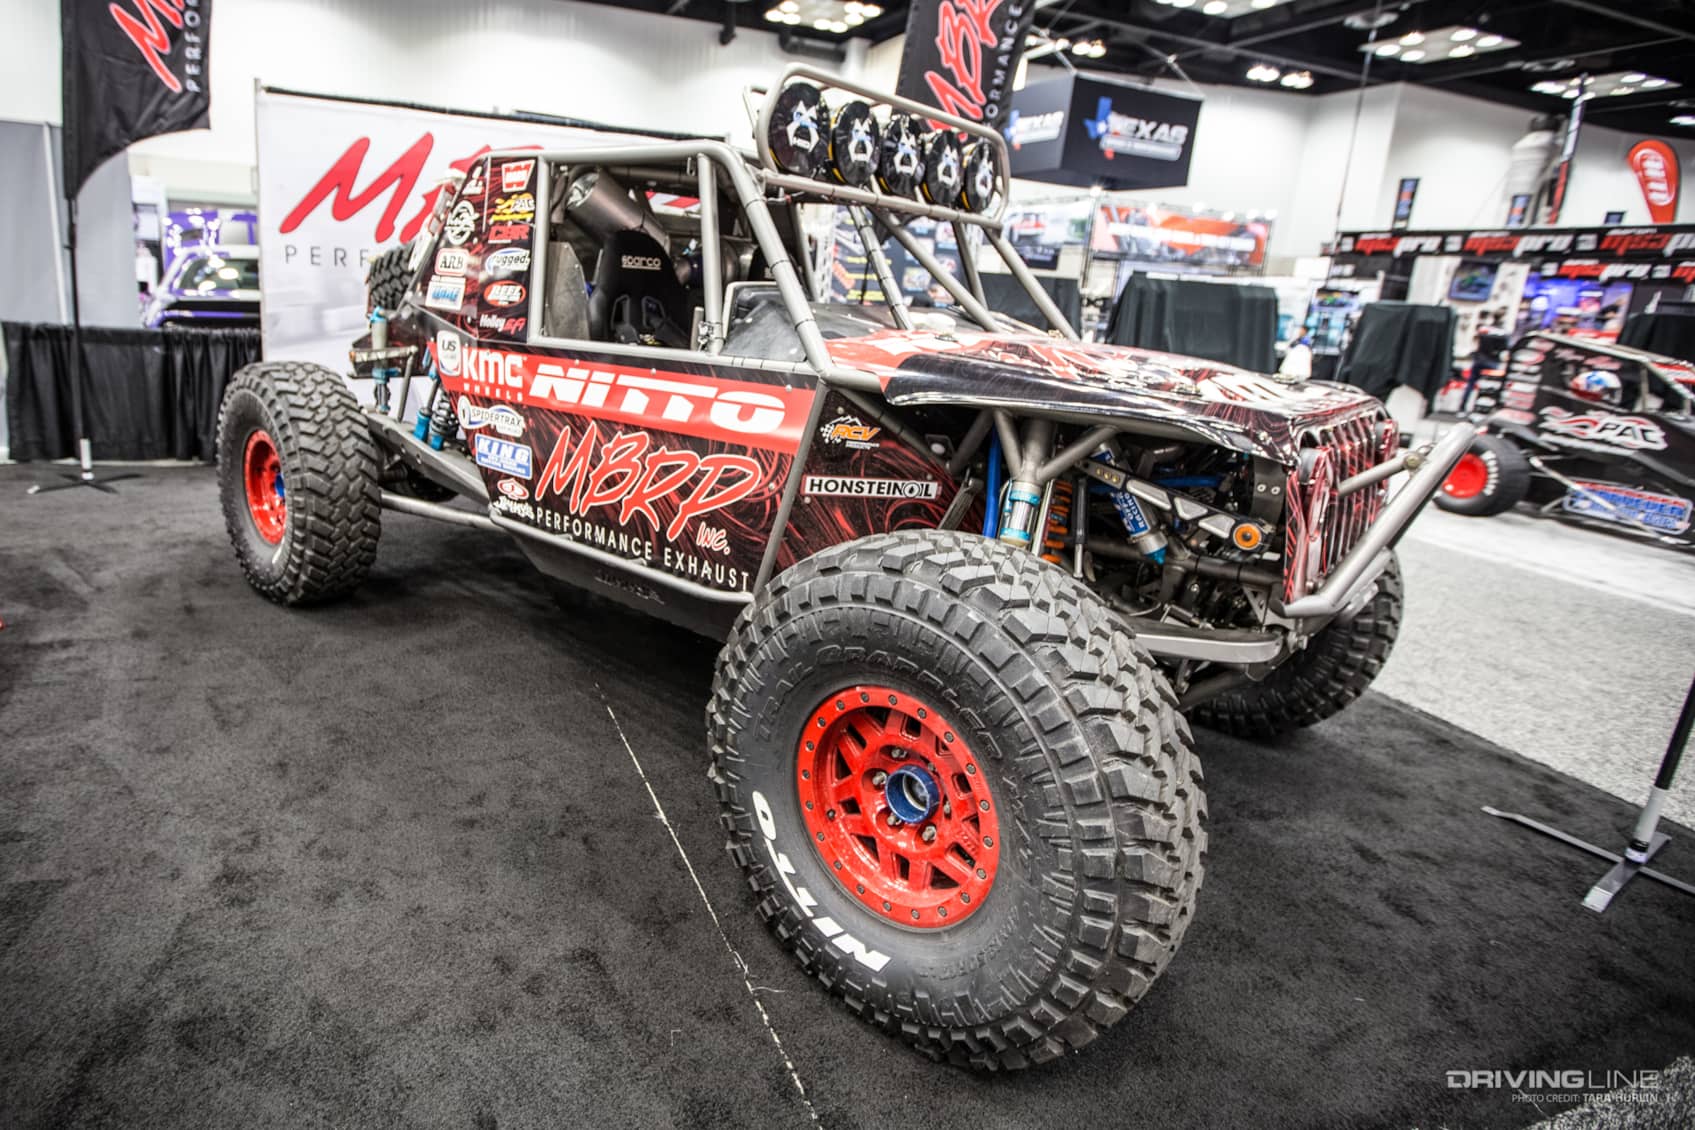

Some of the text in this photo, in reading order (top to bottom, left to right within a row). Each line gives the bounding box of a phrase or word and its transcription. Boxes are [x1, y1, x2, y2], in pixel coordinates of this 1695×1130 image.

[440, 255, 464, 270] ARB
[621, 255, 661, 268] sparco
[529, 363, 786, 434] NITTO
[478, 438, 530, 464] KING
[535, 420, 762, 542] MBRP
[536, 506, 653, 560] PERFORMANCE
[664, 546, 751, 593] EXHAUST
[752, 790, 892, 973] NITTO
